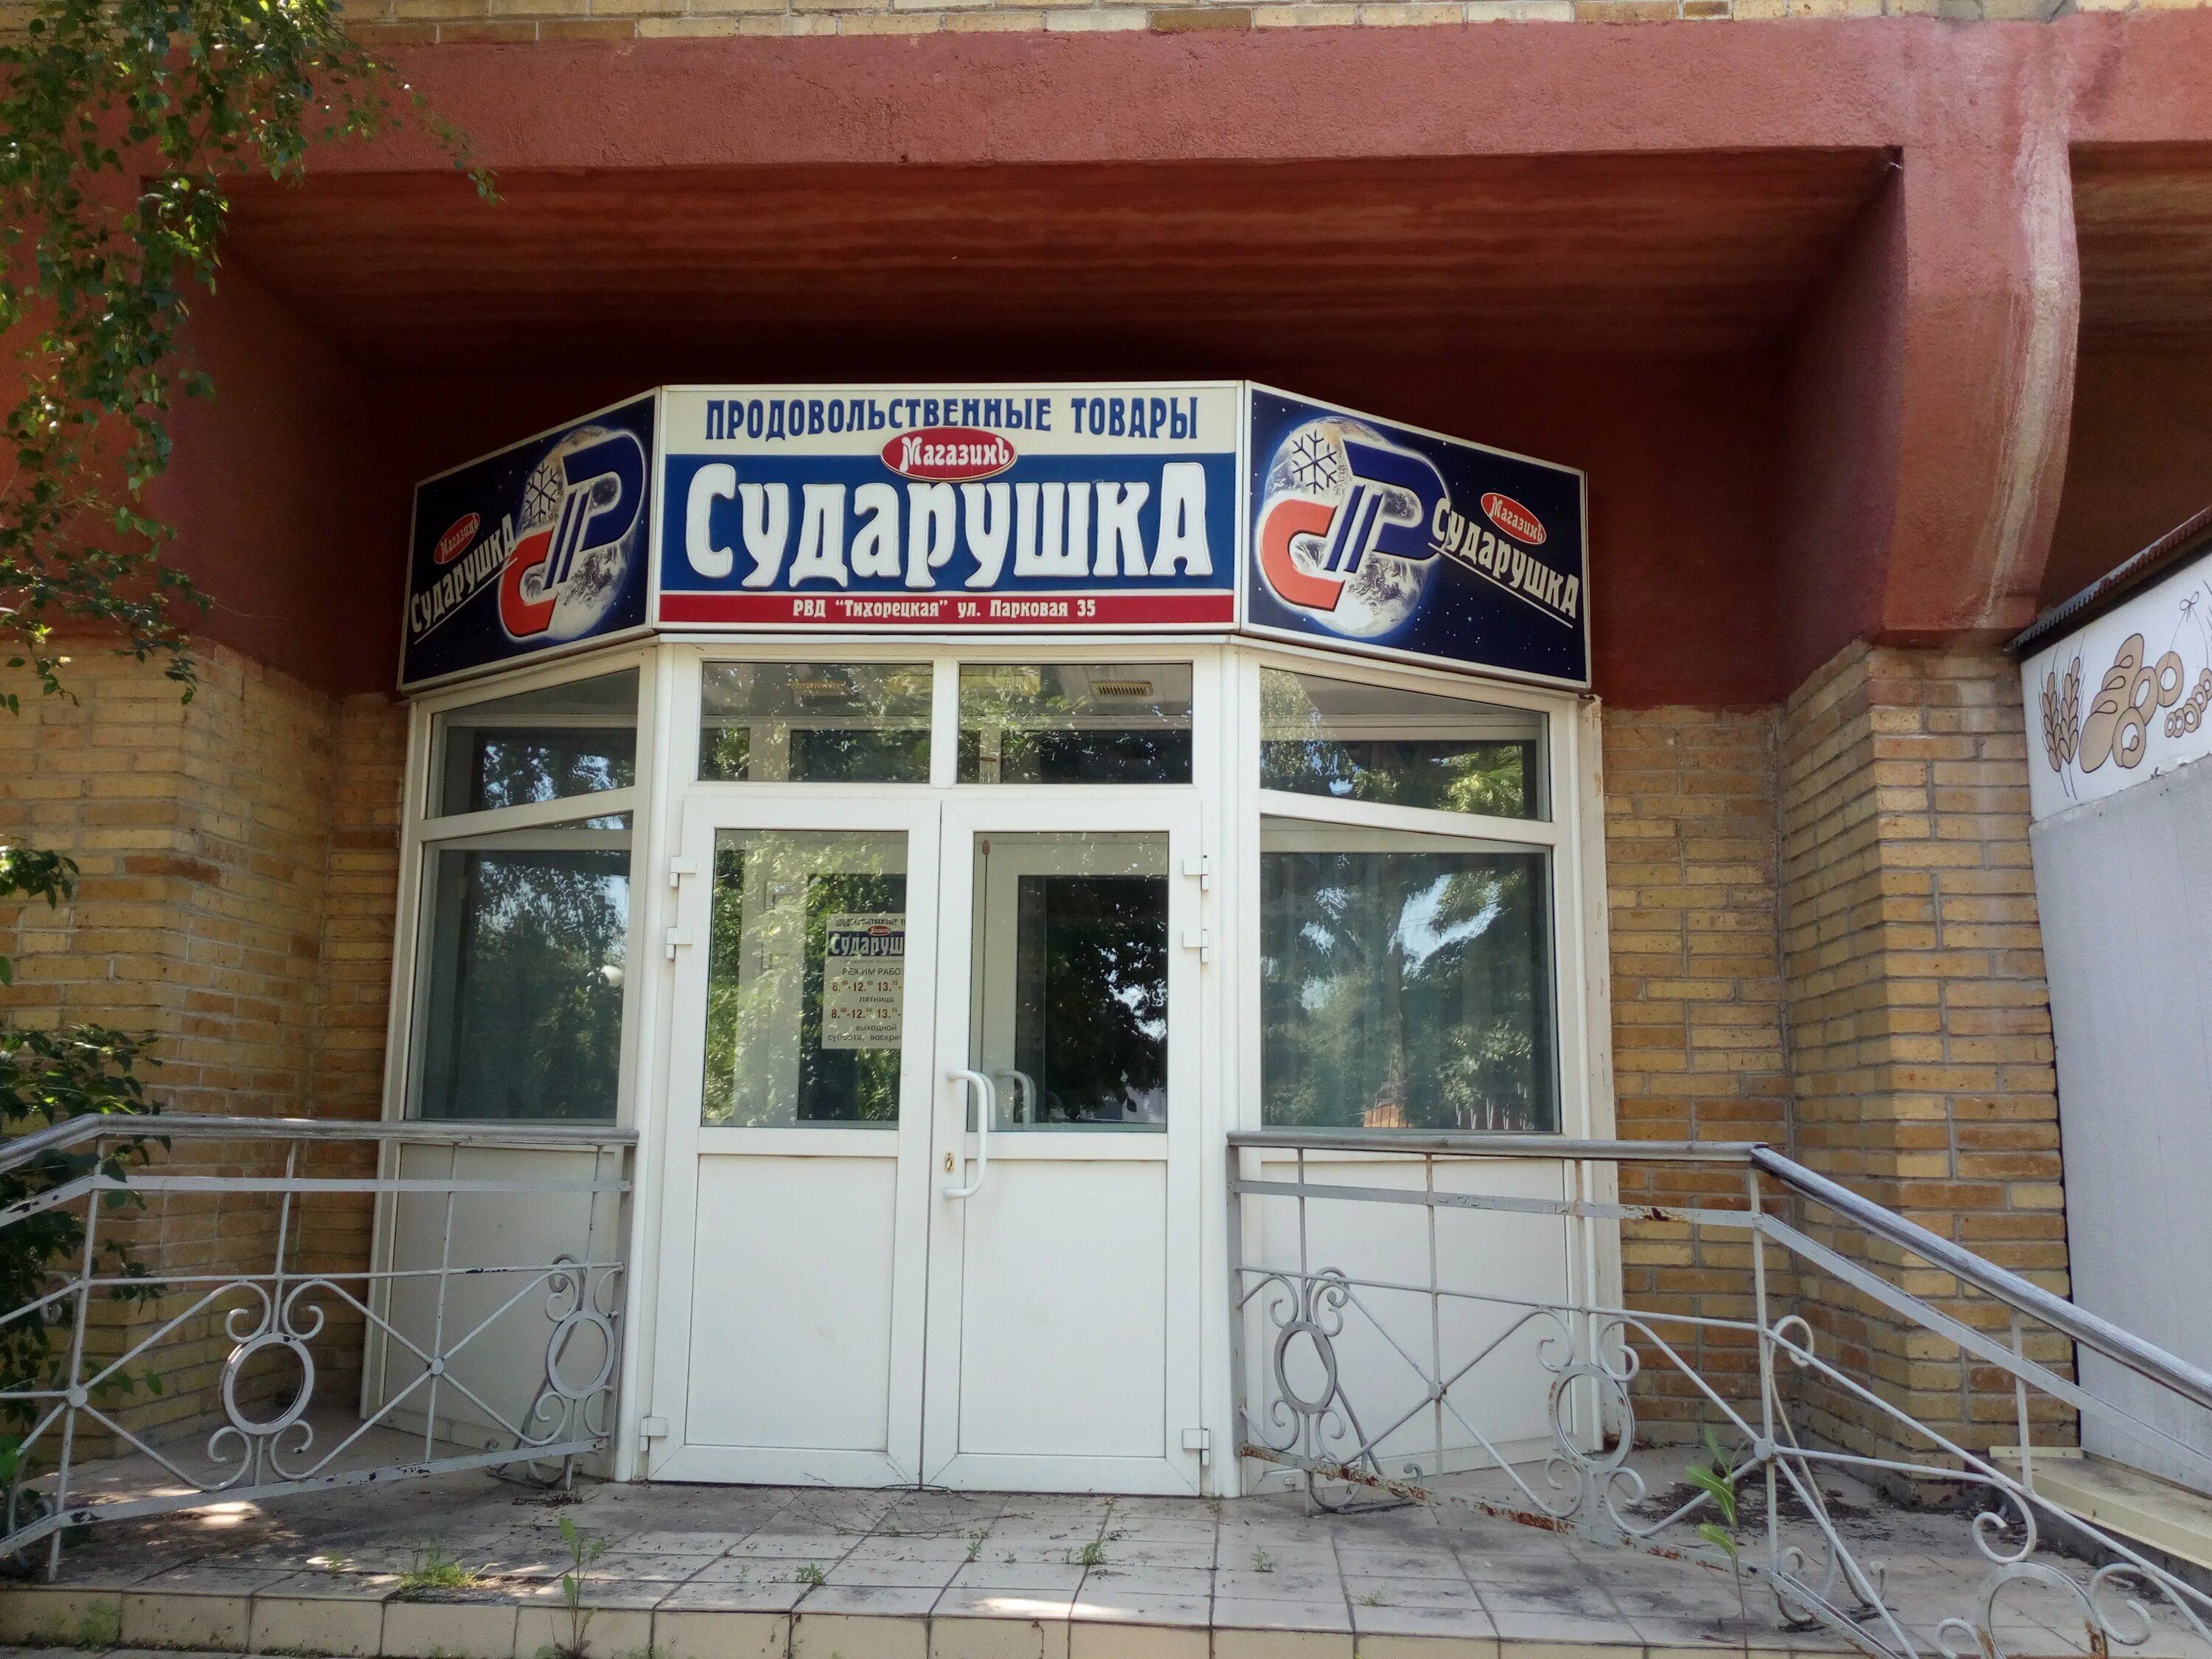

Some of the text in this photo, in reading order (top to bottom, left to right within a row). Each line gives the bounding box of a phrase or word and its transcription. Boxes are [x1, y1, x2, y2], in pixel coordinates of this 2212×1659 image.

[706, 397, 1197, 441] ПРОДОВОЛЬСТВЕННЫЕ ТОВАРЫ
[793, 599, 826, 618] РВД
[958, 599, 981, 618] ул.
[990, 599, 1068, 618] Парковая
[1077, 599, 1096, 617] 35
[842, 967, 874, 975] РЕЖИМ
